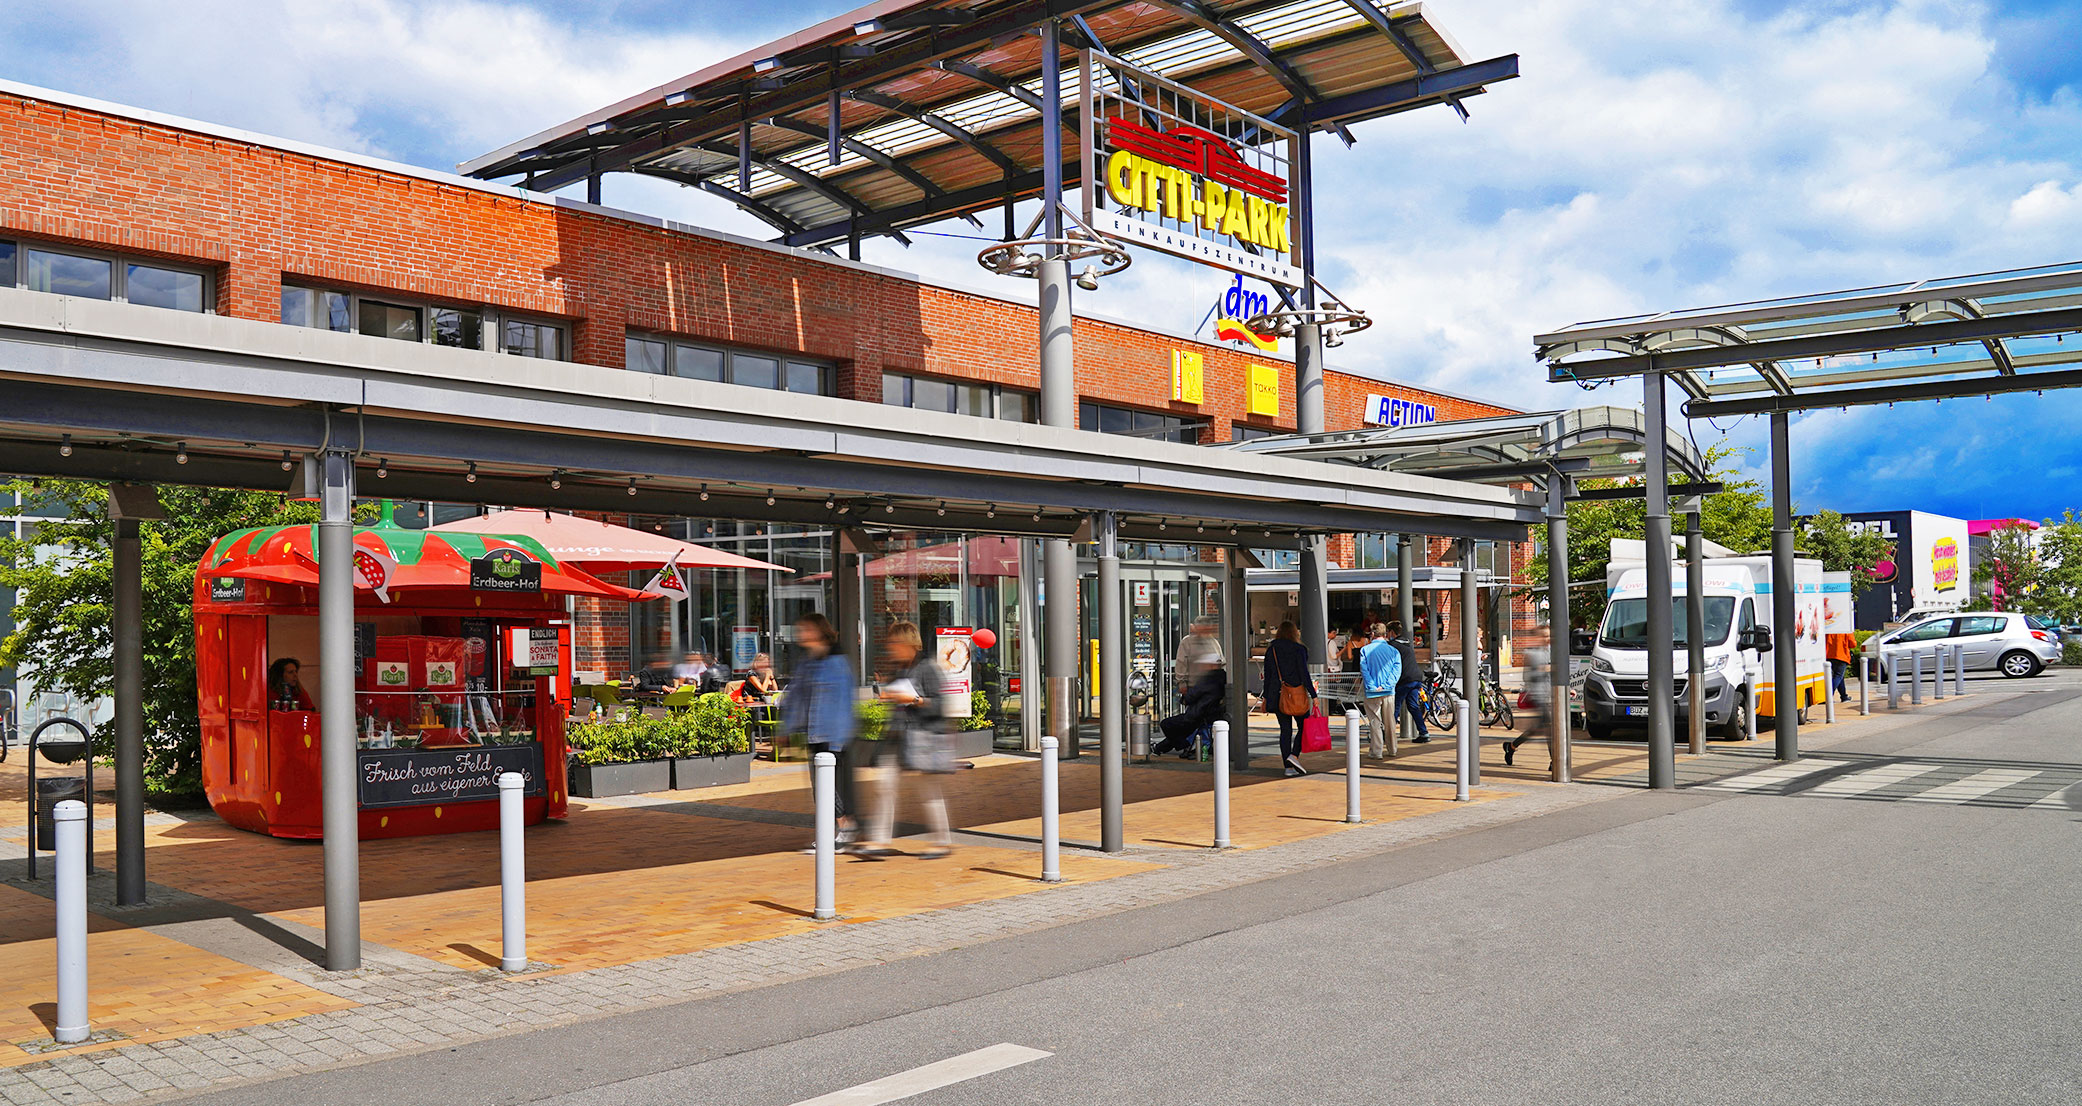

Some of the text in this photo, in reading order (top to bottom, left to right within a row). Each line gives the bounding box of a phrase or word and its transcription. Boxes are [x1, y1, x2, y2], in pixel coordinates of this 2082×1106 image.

[1106, 150, 1289, 253] CITTI-PARK
[1114, 220, 1289, 278] EINKAUFSZENTRUM
[1225, 272, 1268, 319] dm
[1253, 382, 1277, 396] TOKKO
[1378, 396, 1435, 426] ACTION
[542, 543, 615, 557] unge
[494, 561, 520, 574] Karls
[473, 575, 539, 590] Erdbeer-Hof
[212, 587, 244, 598] Erdbeer-Hof
[531, 629, 557, 639] ENDLICH
[529, 645, 558, 654] SONATA
[536, 653, 557, 661] FAITH
[383, 672, 404, 681] Karls
[364, 753, 492, 783] Frisch vom Feld
[411, 780, 438, 794] aus
[440, 774, 491, 797] eigener
